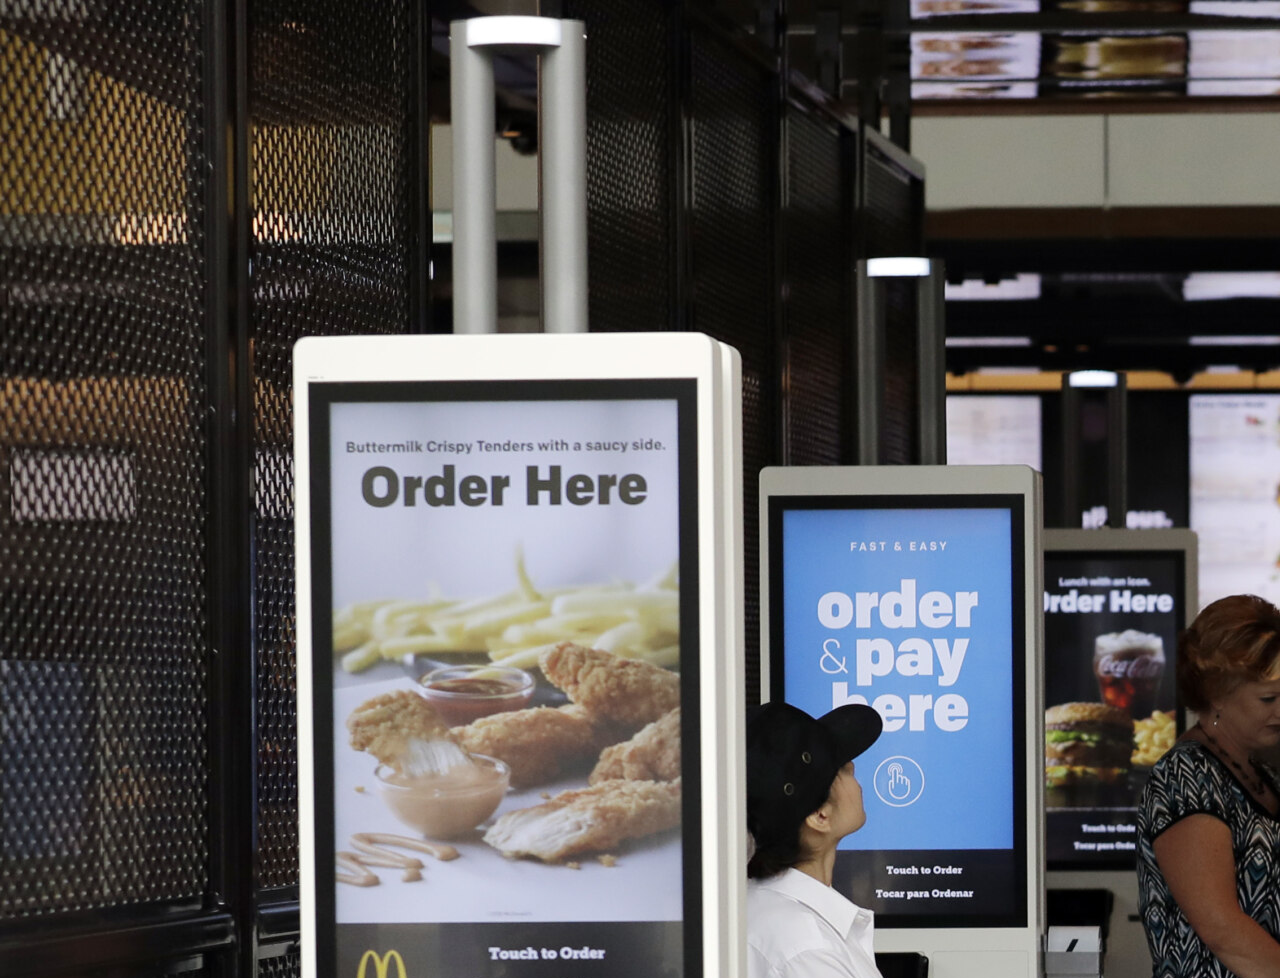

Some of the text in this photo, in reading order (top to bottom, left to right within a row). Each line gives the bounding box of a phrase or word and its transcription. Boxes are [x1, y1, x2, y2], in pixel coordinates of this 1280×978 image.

[346, 438, 666, 454] Buttermilk Crispy Tenders with a saucy side.
[362, 464, 647, 507] Order Here
[850, 541, 947, 551] FAST & EASY
[1059, 576, 1088, 587] Lunch
[1112, 578, 1126, 587] an
[817, 578, 979, 629] order
[1110, 589, 1174, 613] Here
[820, 637, 970, 687] & pay
[1082, 824, 1106, 833] Touch
[1107, 824, 1116, 833] to
[886, 865, 963, 875] Touch to Order
[875, 889, 974, 900] Tocar para Ordenar
[488, 946, 606, 960] Touch to Order
